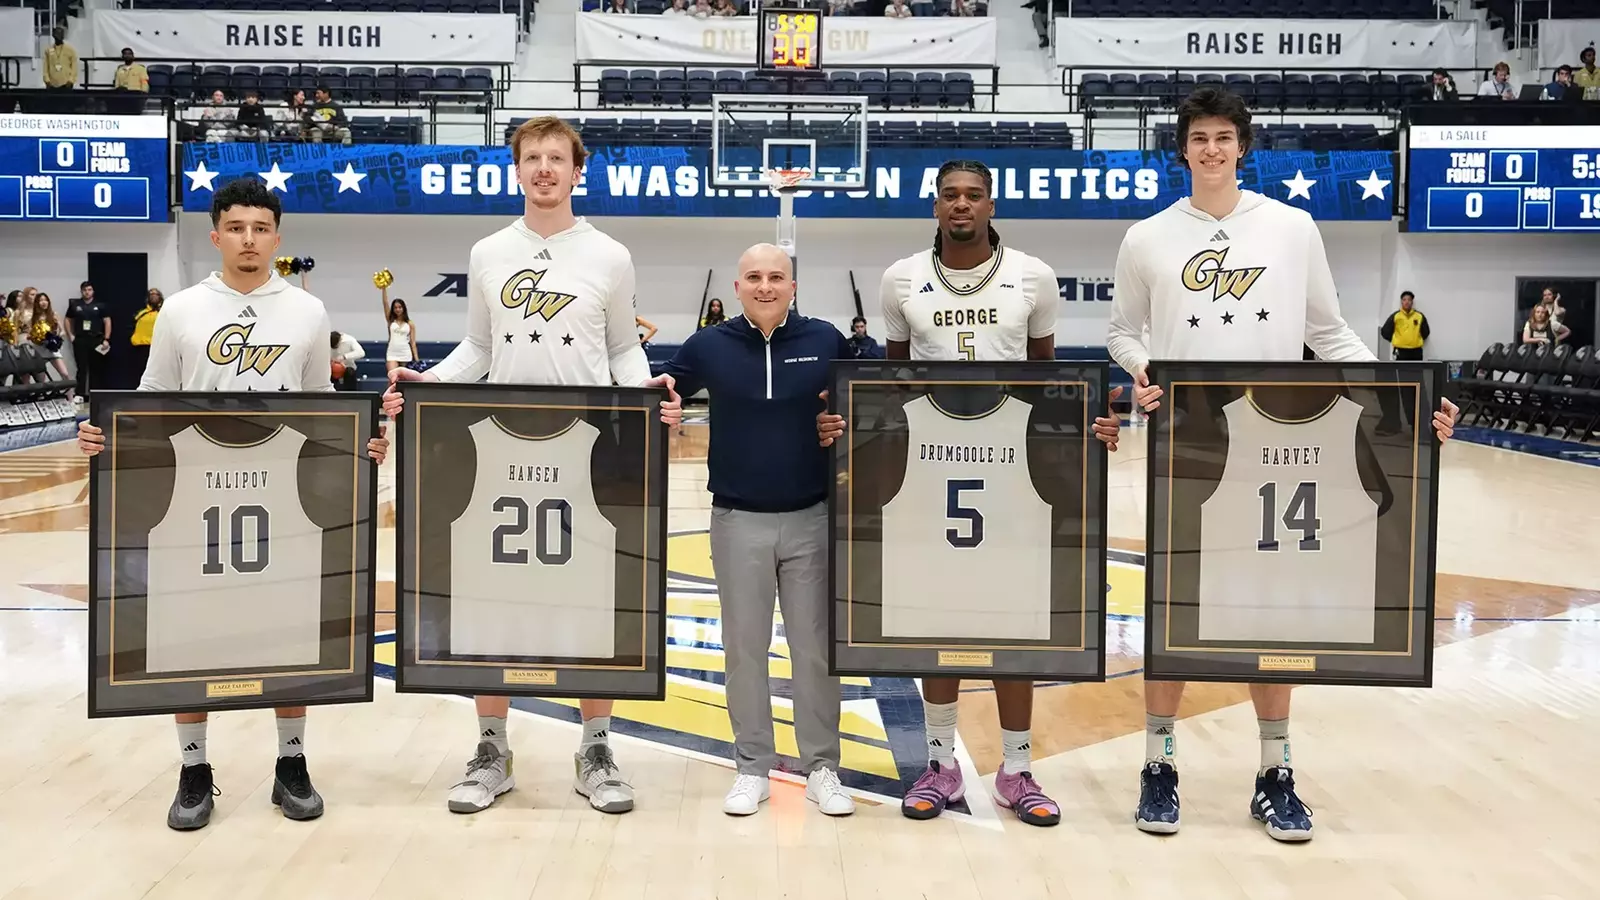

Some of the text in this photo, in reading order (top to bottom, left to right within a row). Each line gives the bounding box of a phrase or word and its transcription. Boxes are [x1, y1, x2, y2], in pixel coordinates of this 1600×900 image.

[226, 24, 382, 48] RAISE HIGH
[702, 29, 870, 51] ONL GW
[1186, 32, 1342, 55] RAISE HIGH
[773, 34, 811, 65] 30
[0, 118, 120, 130] GEORGE WASHINGTON
[1440, 130, 1488, 141] LA SALLE
[57, 142, 74, 167] 0
[90, 142, 126, 157] TEAM
[1450, 153, 1486, 168] TEAM
[91, 158, 130, 173] FOULS
[1446, 168, 1486, 184] FOULS
[1506, 154, 1523, 179] 0
[1572, 153, 1600, 179] 5:
[94, 182, 112, 208] 0
[919, 167, 1159, 200] ALETICS
[1465, 192, 1483, 218] 0
[1181, 246, 1267, 302] GW
[500, 268, 578, 322] GW
[933, 308, 999, 327] GEORGE
[206, 321, 290, 376] GW
[957, 331, 976, 360] 5
[920, 443, 1016, 464] DRUMGOOLE JR
[1262, 447, 1322, 466] HARVEY
[205, 470, 270, 490] TALIPOV
[508, 464, 561, 483] HANSEN
[944, 478, 986, 550] 5
[1256, 481, 1322, 552] 14
[201, 504, 271, 576] 10
[491, 496, 572, 566] 20
